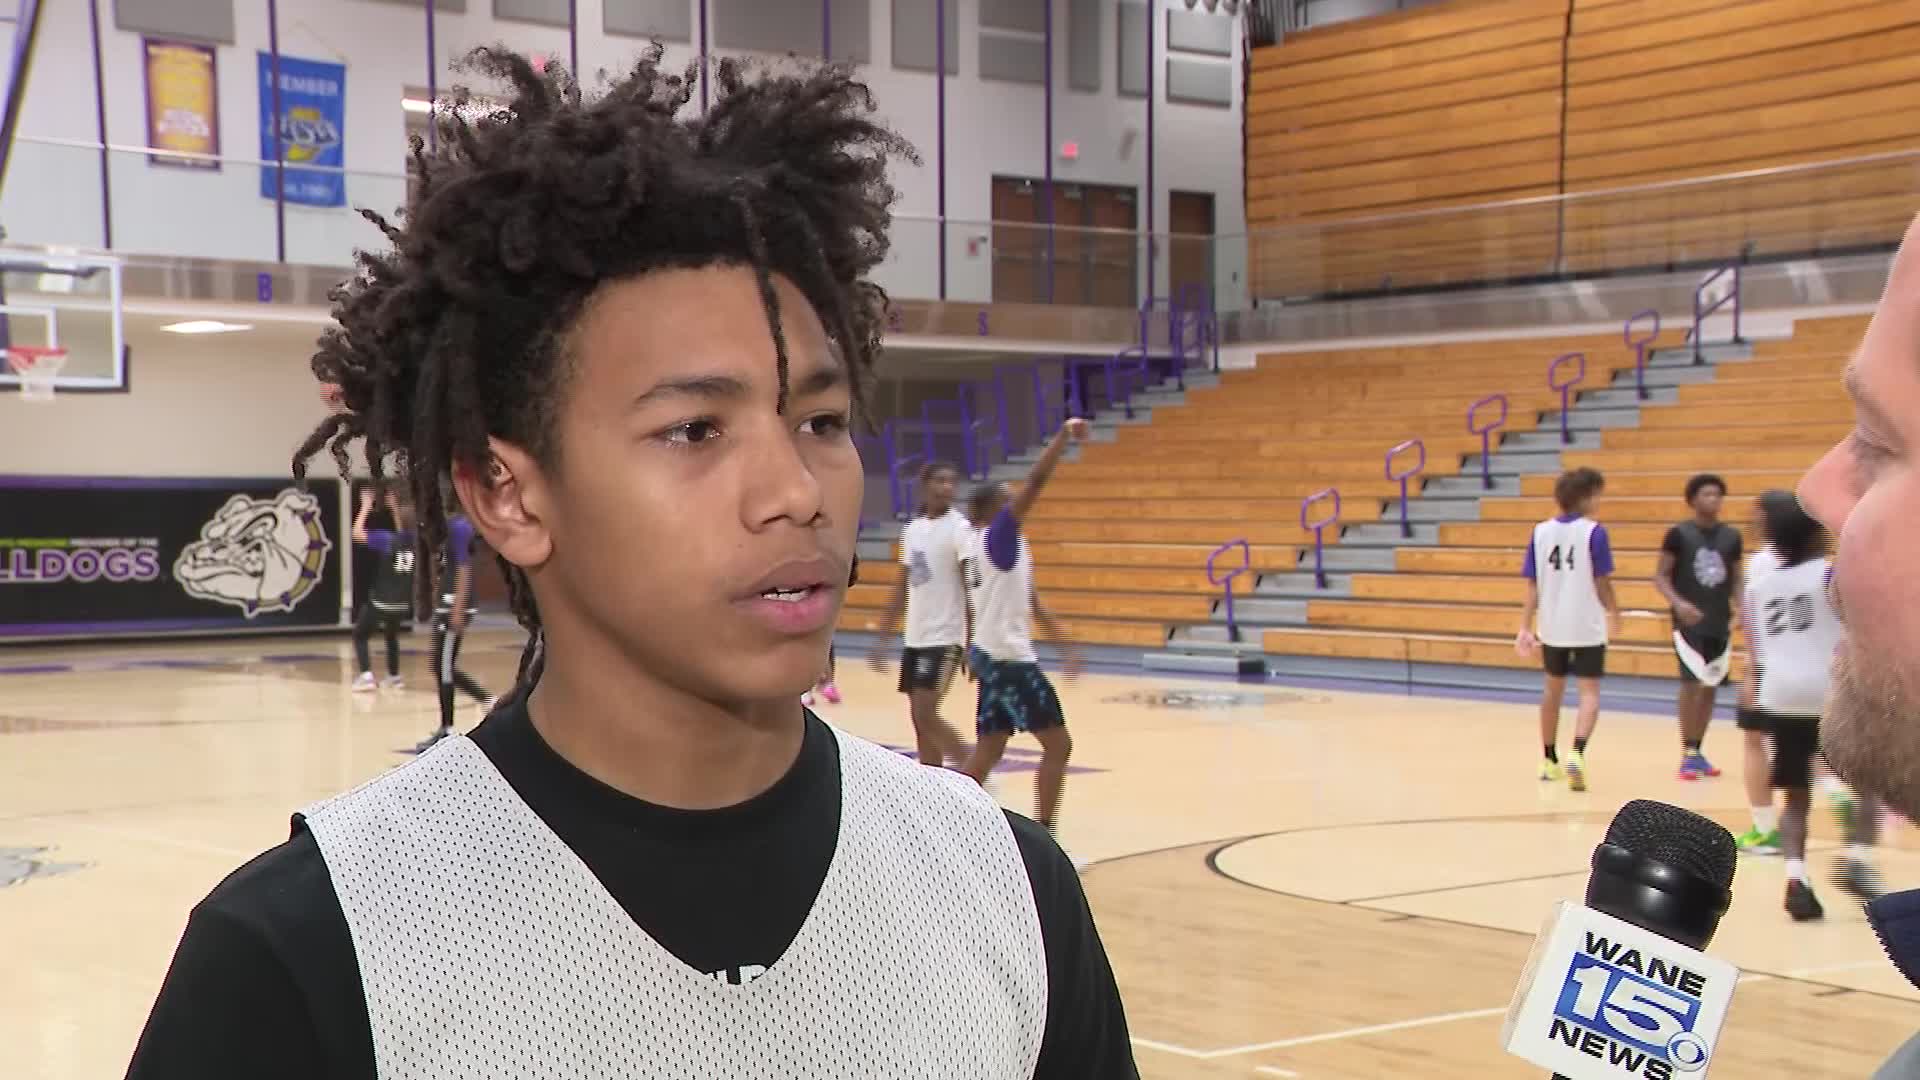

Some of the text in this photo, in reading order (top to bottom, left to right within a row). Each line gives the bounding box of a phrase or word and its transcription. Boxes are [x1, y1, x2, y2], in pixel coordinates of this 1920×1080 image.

[1549, 544, 1575, 571] 44
[1765, 594, 1815, 635] 20
[1585, 931, 1706, 998] WANE
[1573, 965, 1692, 1048] 15
[1549, 1018, 1674, 1080] NEWS
